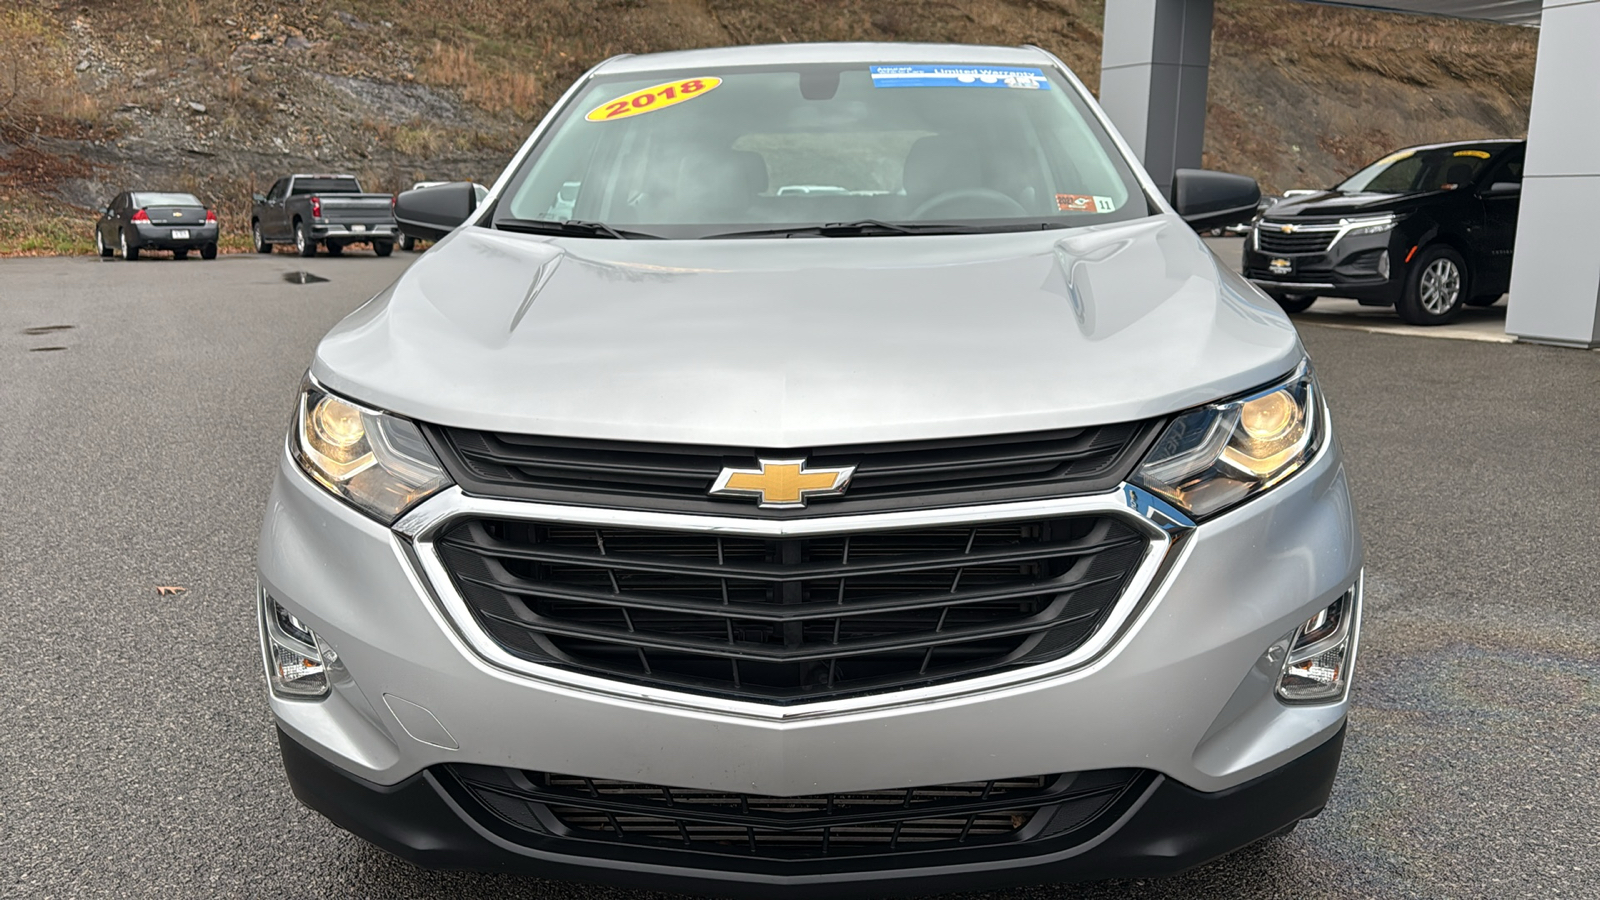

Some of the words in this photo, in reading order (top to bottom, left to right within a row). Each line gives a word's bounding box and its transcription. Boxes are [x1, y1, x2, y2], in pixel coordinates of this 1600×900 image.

[933, 68, 978, 76] Limited
[605, 80, 706, 118] 2018
[1099, 200, 1111, 210] 11
